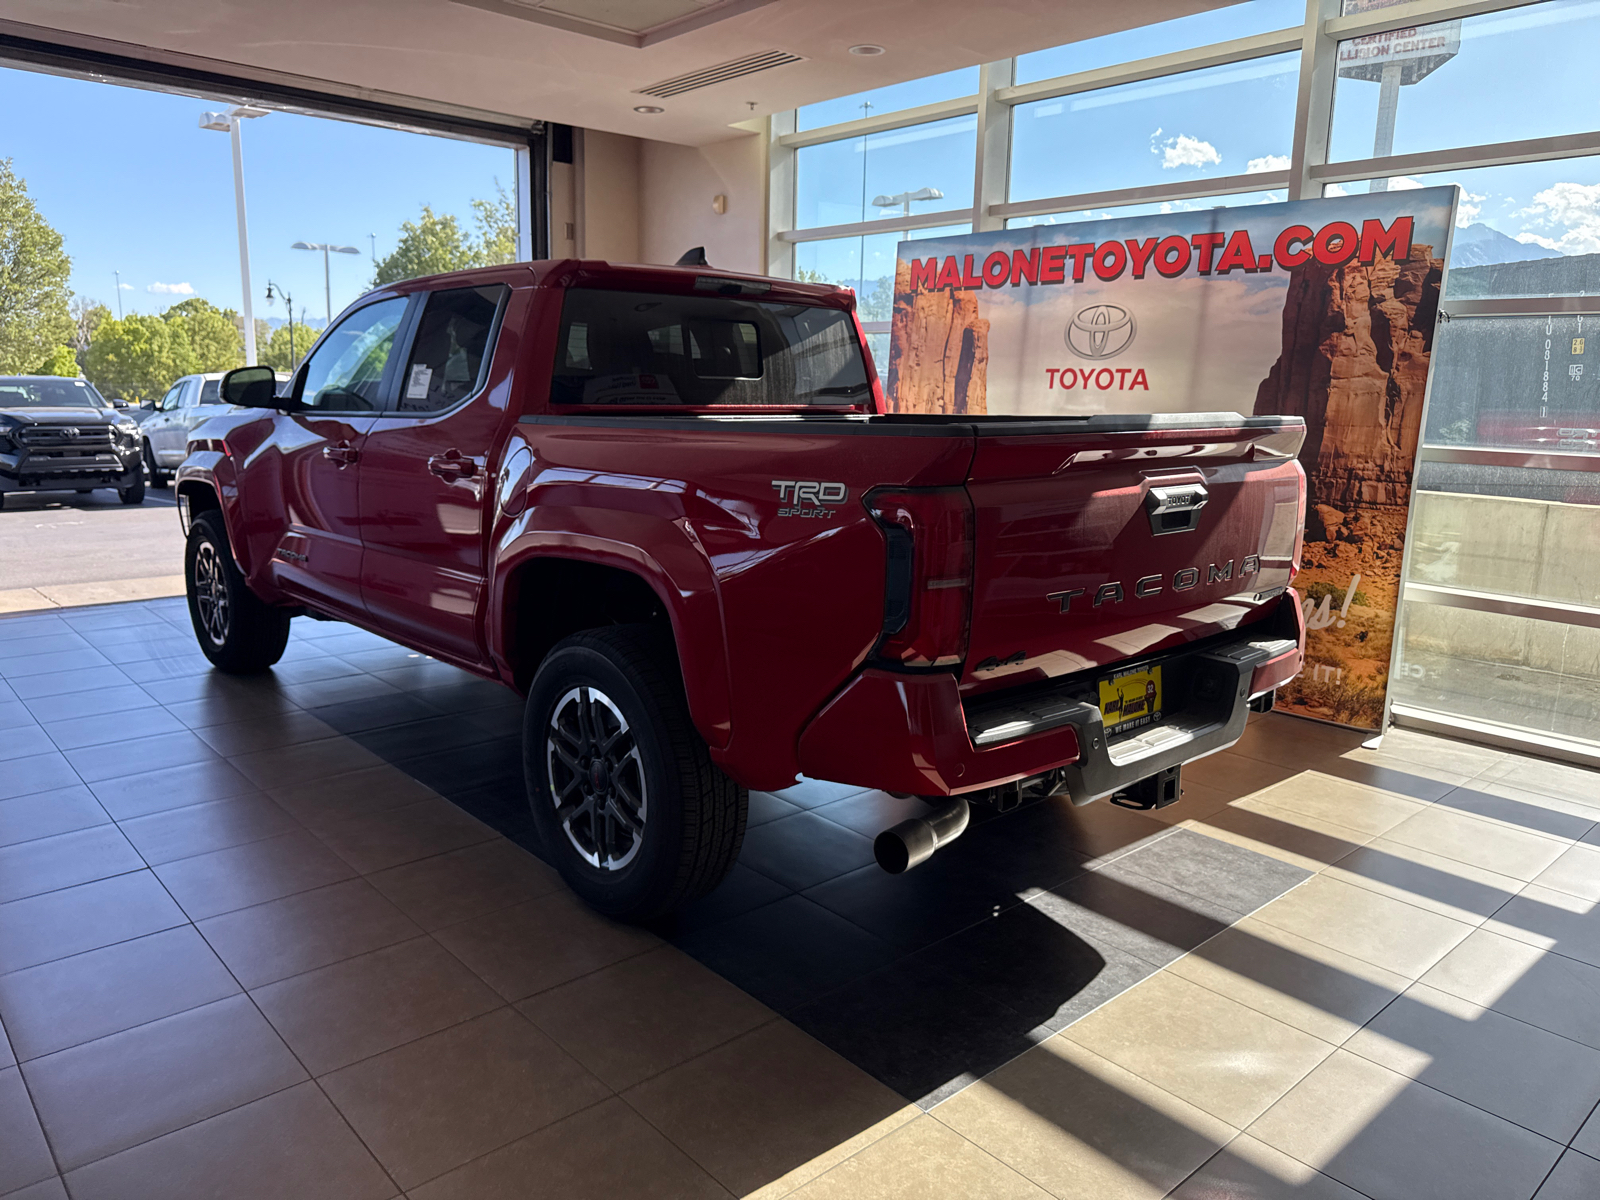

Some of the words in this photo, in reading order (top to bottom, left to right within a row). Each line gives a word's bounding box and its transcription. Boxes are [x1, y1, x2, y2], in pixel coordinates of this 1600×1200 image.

[1340, 44, 1390, 60] LLISION
[1393, 36, 1446, 54] CENTER
[1352, 28, 1417, 47] CERTIFIED
[910, 216, 1415, 293] MALONETOYOTA.COM
[1045, 368, 1150, 391] TOYOTA
[771, 480, 848, 508] TRD
[777, 508, 836, 519] SPORT
[1046, 554, 1261, 614] TACOMA
[1313, 664, 1342, 685] IT!
